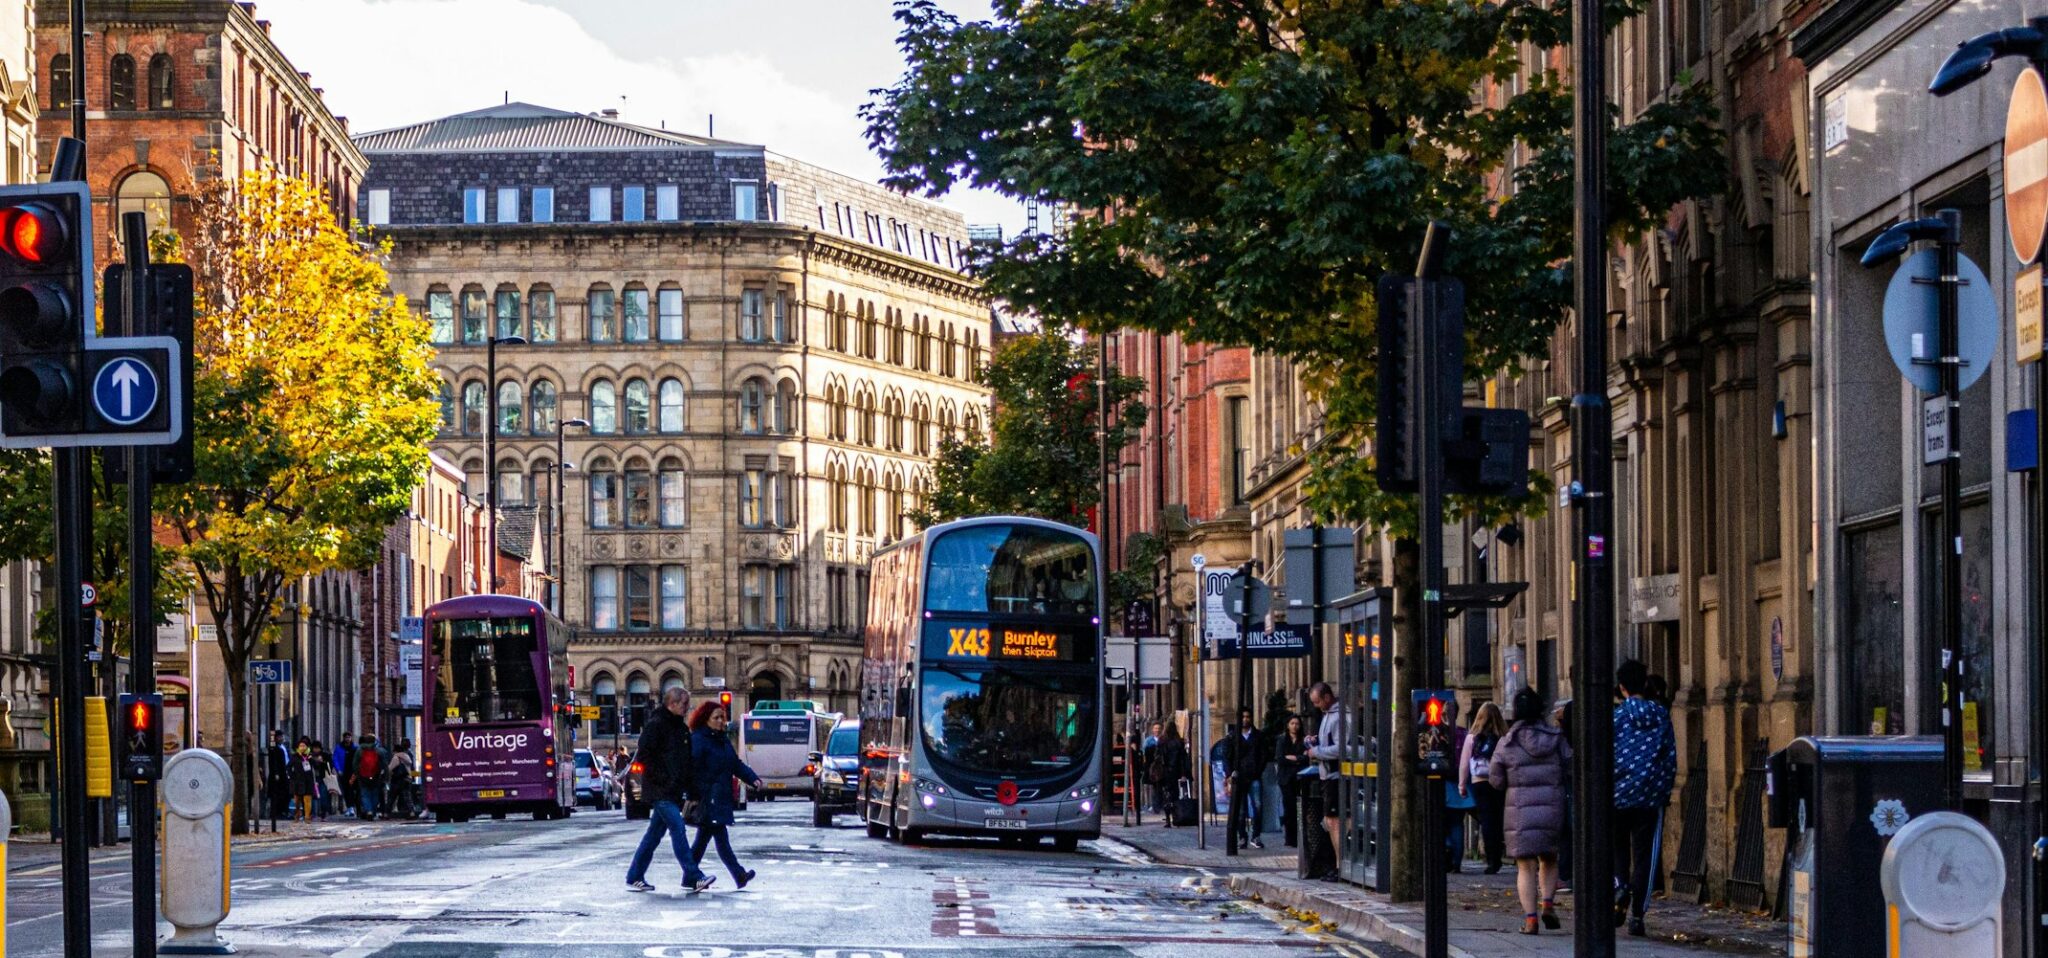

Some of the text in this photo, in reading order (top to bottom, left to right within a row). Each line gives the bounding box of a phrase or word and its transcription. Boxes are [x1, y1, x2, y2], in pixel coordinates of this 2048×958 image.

[2018, 285, 2038, 313] Except
[2020, 322, 2037, 346] trams
[1926, 406, 1945, 428] Except
[1928, 434, 1944, 452] trams
[947, 628, 990, 656] X43
[1004, 630, 1056, 649] Burnley
[1002, 645, 1057, 658] then Skipton
[448, 731, 528, 752] Vantage
